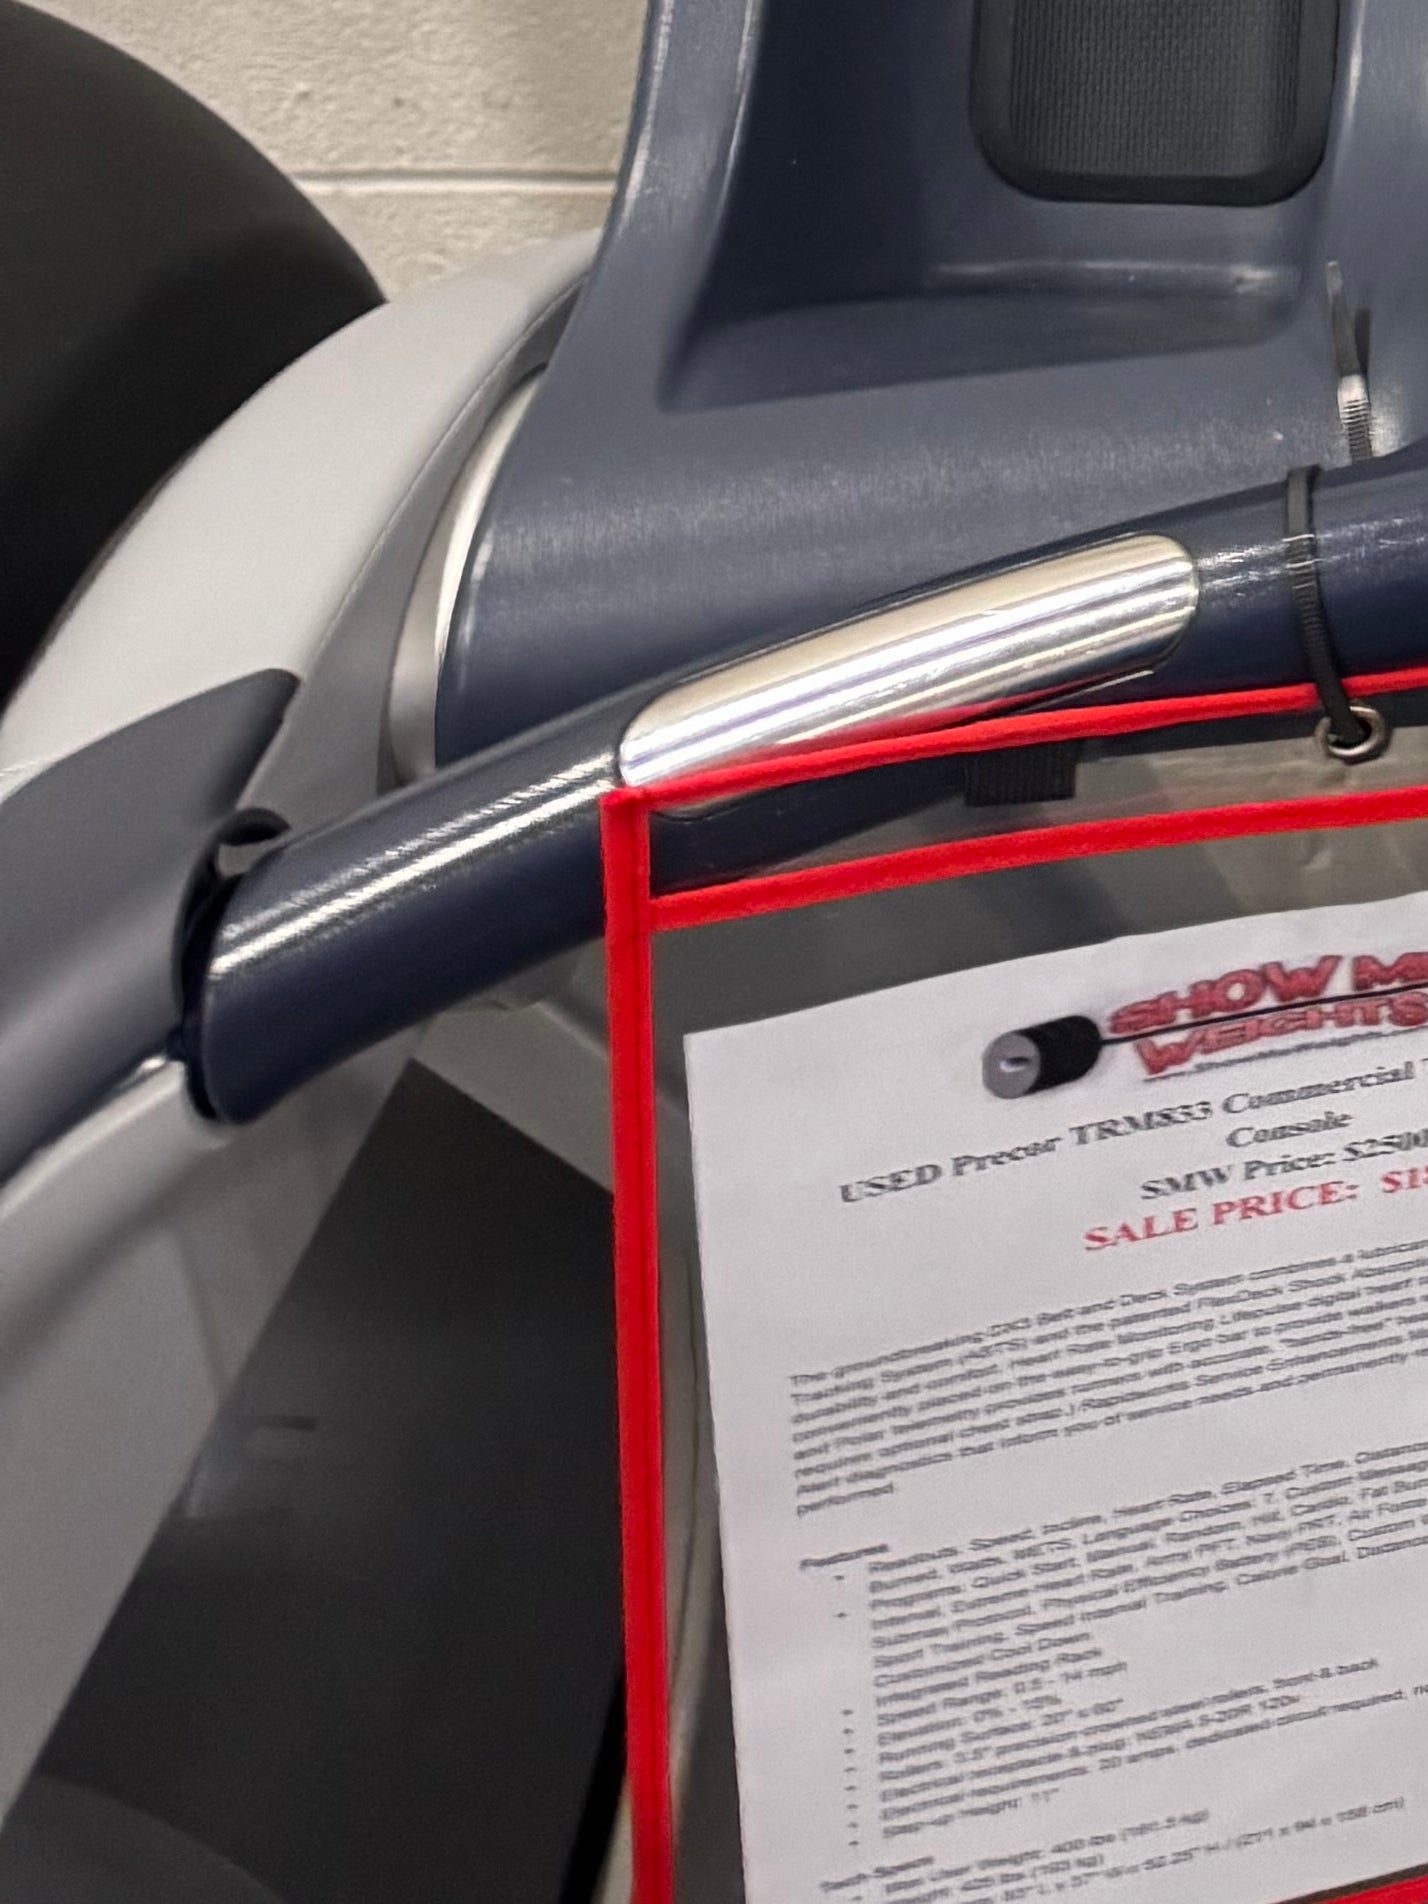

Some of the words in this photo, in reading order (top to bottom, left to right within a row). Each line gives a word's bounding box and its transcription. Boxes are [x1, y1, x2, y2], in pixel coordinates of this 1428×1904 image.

[1109, 955, 1342, 1035] SHOW
[840, 1164, 943, 1203] USED
[951, 1137, 1061, 1177] Precor
[1069, 1100, 1213, 1145] TRM833
[1222, 1061, 1414, 1114] Commercial
[1226, 1110, 1354, 1149] Console
[1141, 1163, 1233, 1200] SMW
[1243, 1152, 1336, 1182] Price:
[1084, 1206, 1198, 1250] SALE
[1213, 1180, 1359, 1226] PRICE:
